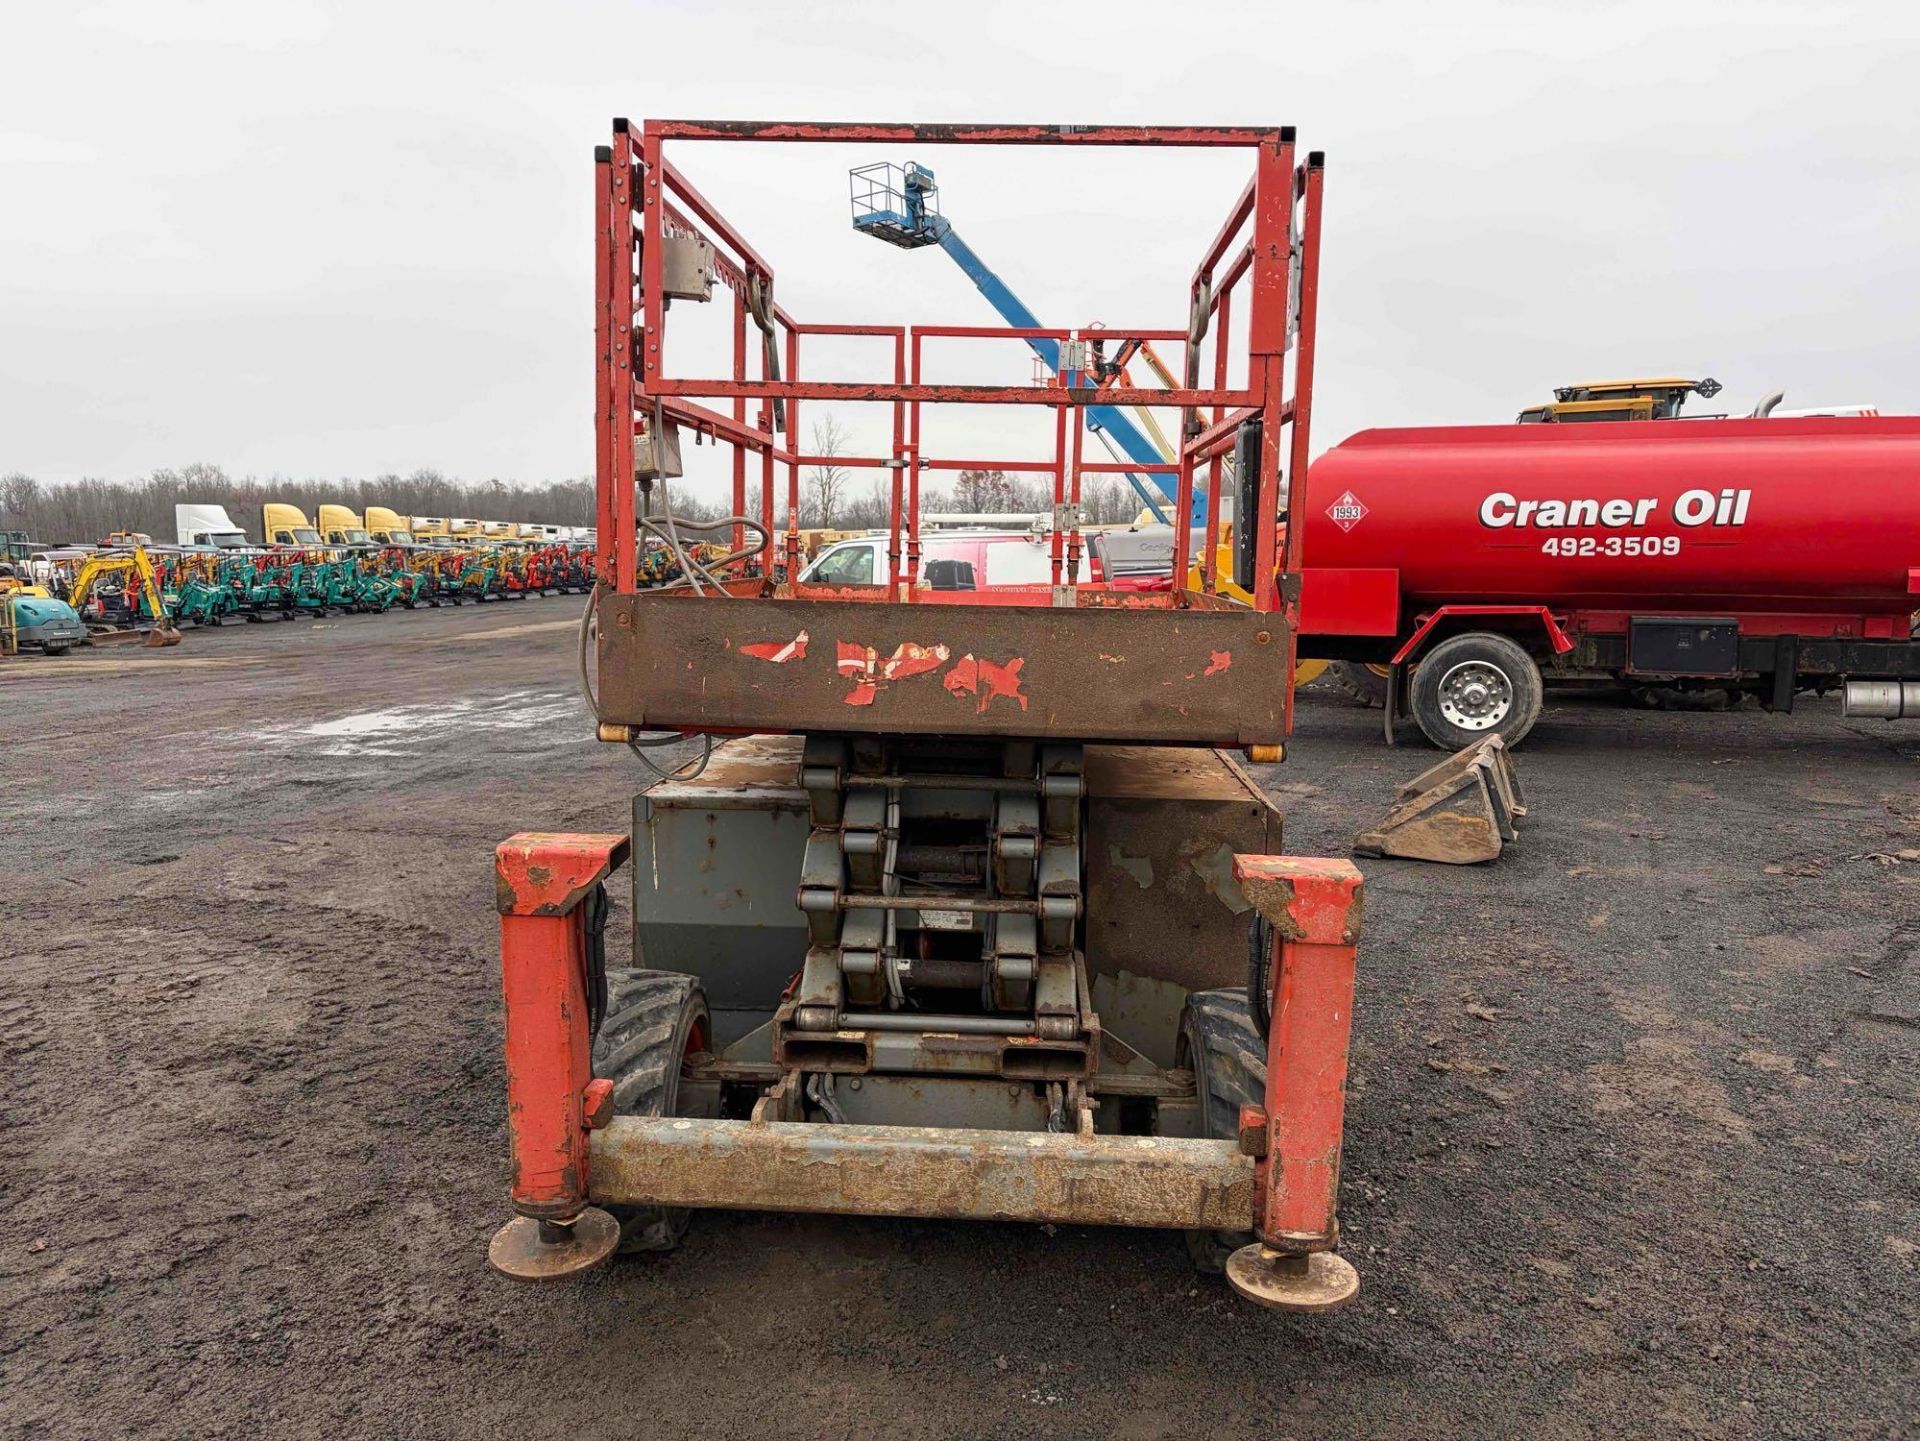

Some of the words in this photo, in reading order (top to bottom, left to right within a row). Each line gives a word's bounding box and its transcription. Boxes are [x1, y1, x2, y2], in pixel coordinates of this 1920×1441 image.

[1335, 507, 1359, 518] 1993
[1479, 491, 1659, 529] Craner
[1672, 488, 1752, 527] Oil
[1541, 536, 1681, 557] 492-3509
